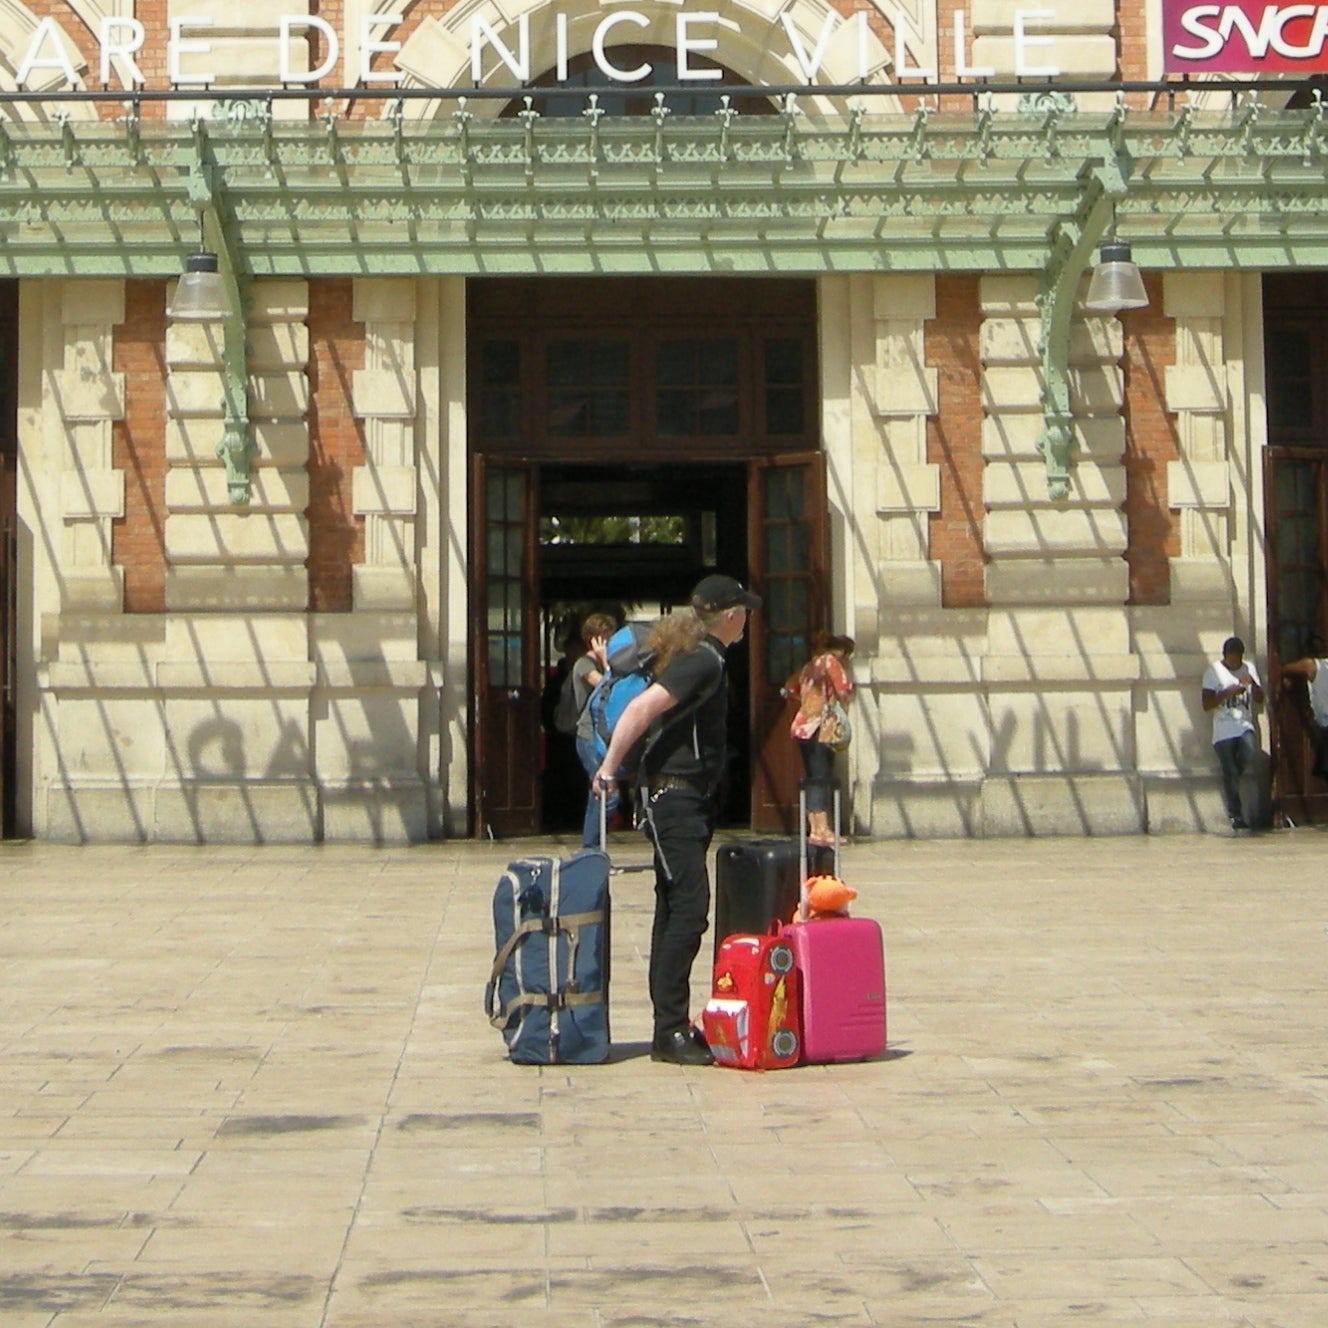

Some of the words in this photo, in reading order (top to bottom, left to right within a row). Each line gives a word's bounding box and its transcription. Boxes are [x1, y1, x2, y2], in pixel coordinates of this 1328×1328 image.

[278, 13, 404, 83] DE
[471, 8, 724, 82] NICE
[780, 7, 1062, 81] VILLE
